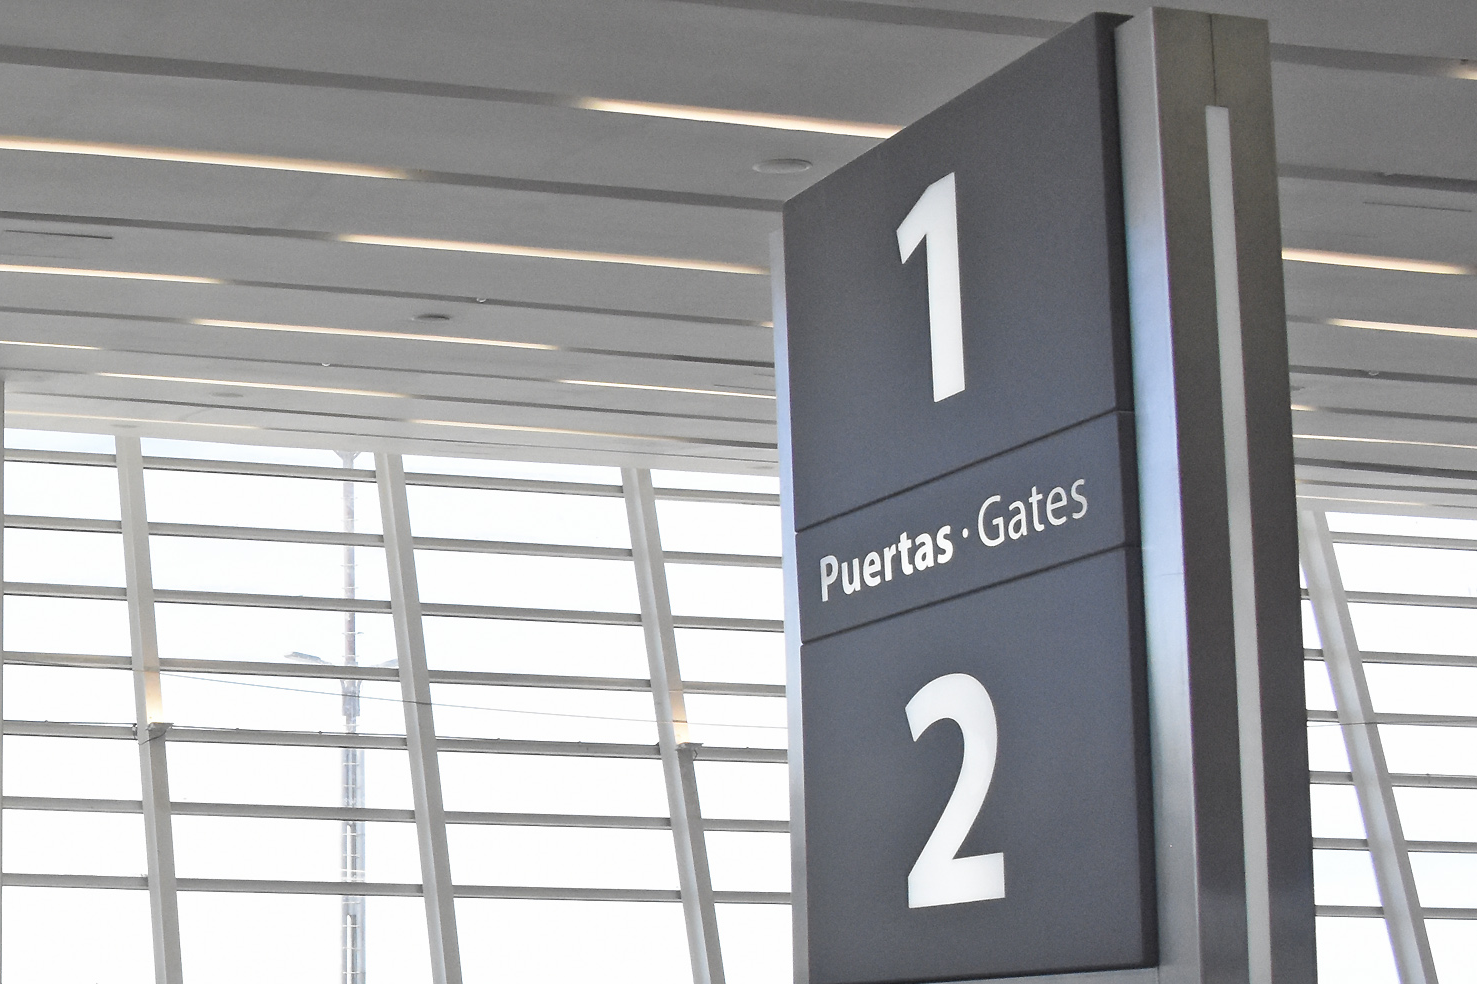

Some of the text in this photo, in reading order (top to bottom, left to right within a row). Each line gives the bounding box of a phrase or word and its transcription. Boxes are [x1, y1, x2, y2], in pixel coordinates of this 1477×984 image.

[897, 173, 965, 402] 1
[820, 479, 1087, 602] Puertas Gates
[905, 674, 1005, 908] 2
